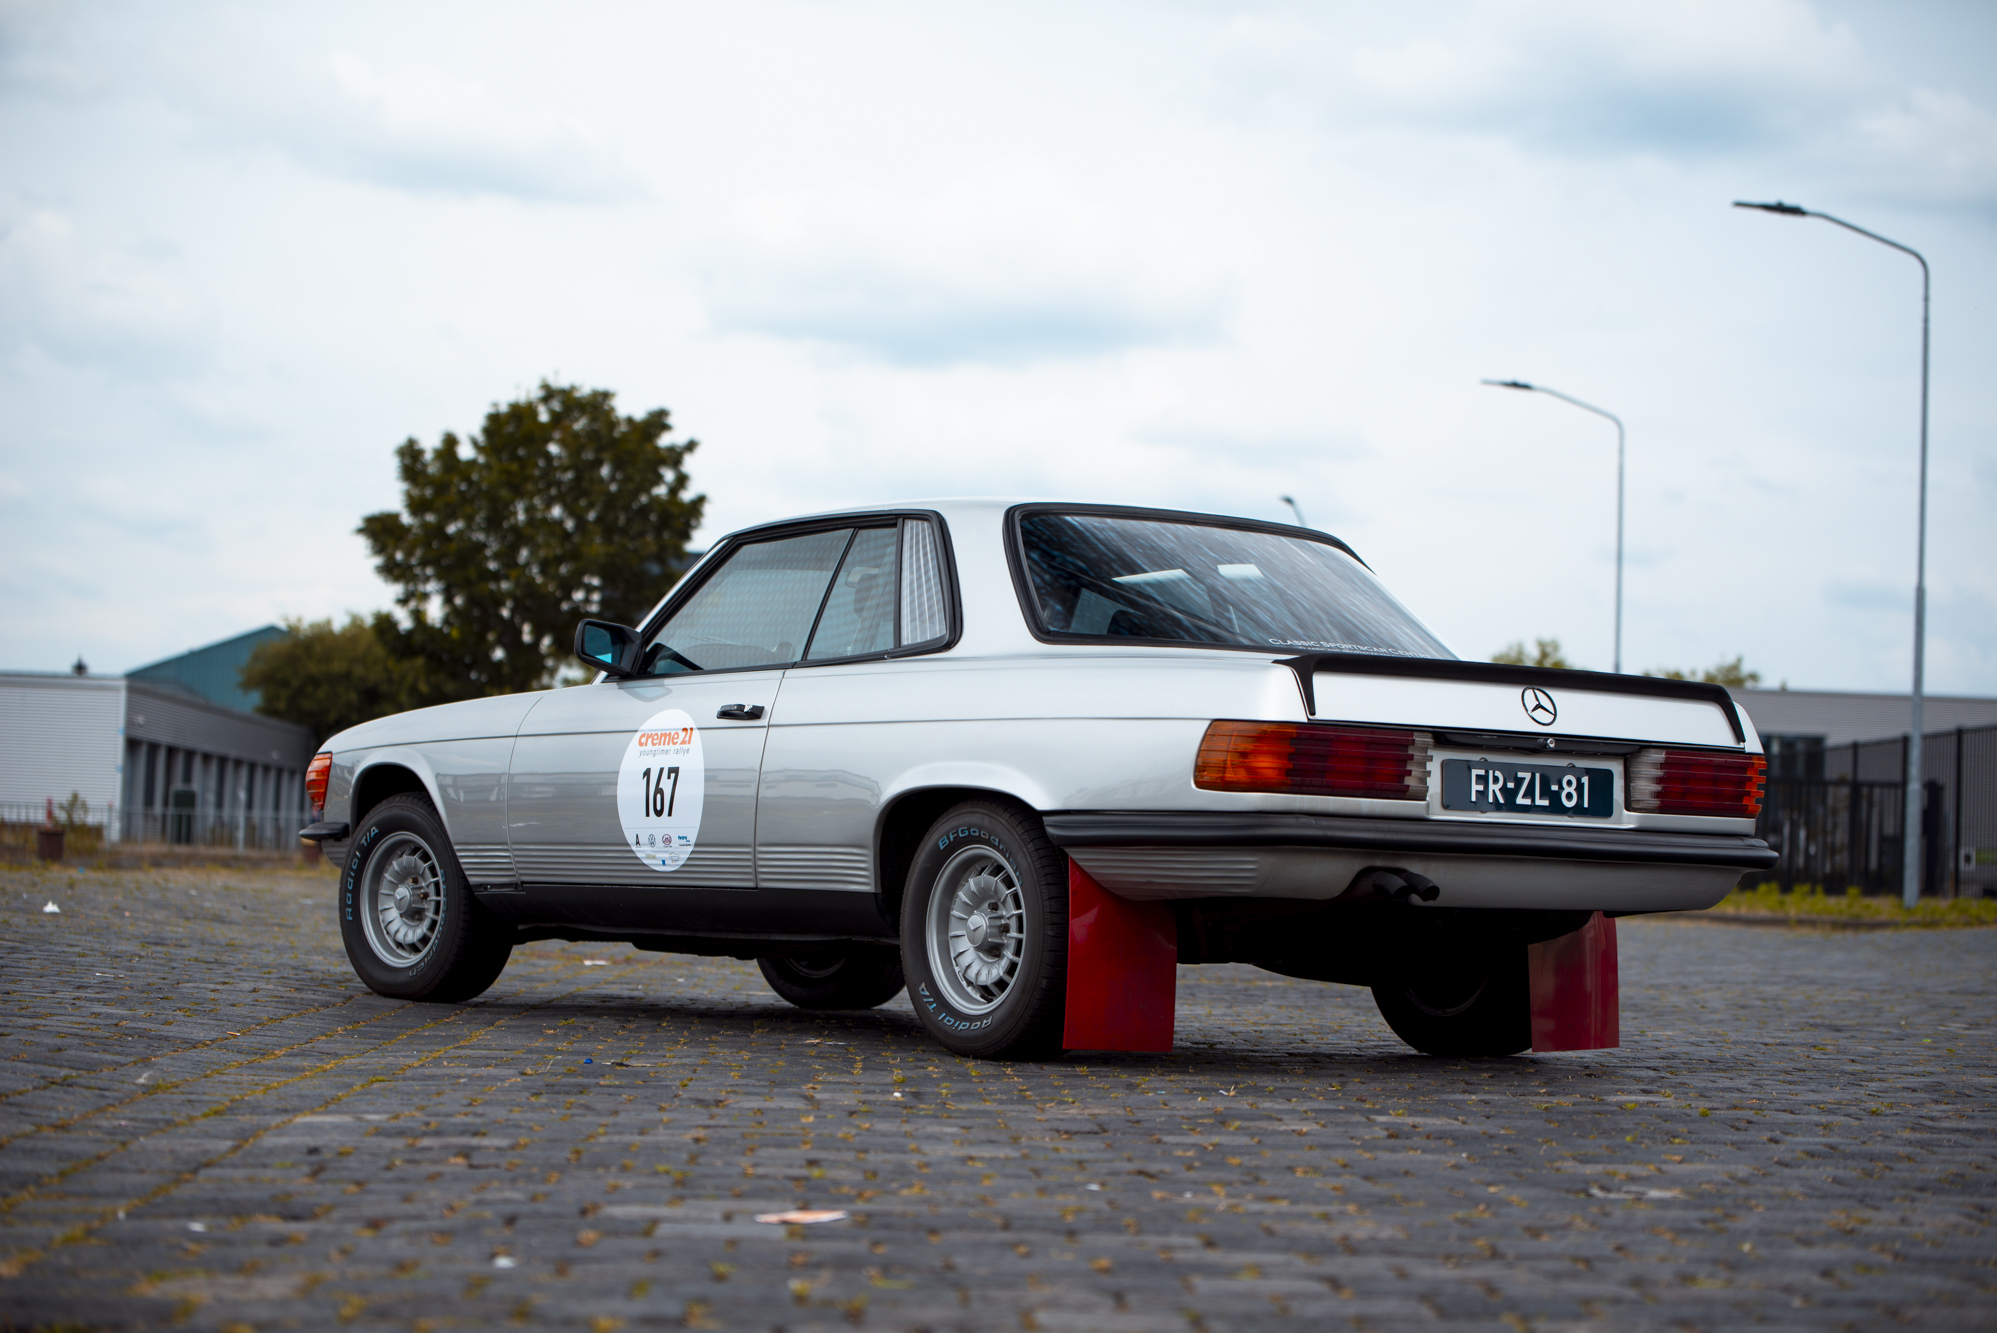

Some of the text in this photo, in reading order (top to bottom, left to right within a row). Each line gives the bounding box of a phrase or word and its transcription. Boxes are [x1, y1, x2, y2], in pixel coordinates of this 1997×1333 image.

[1268, 638, 1320, 647] CLASSIC
[638, 746, 690, 758] youngtimer rallye
[642, 766, 680, 818] 167
[1470, 768, 1589, 809] FR-ZL-81
[360, 826, 379, 847] T/A
[938, 826, 1023, 886] BFGoodrich
[918, 981, 993, 1031] Radial T/A
